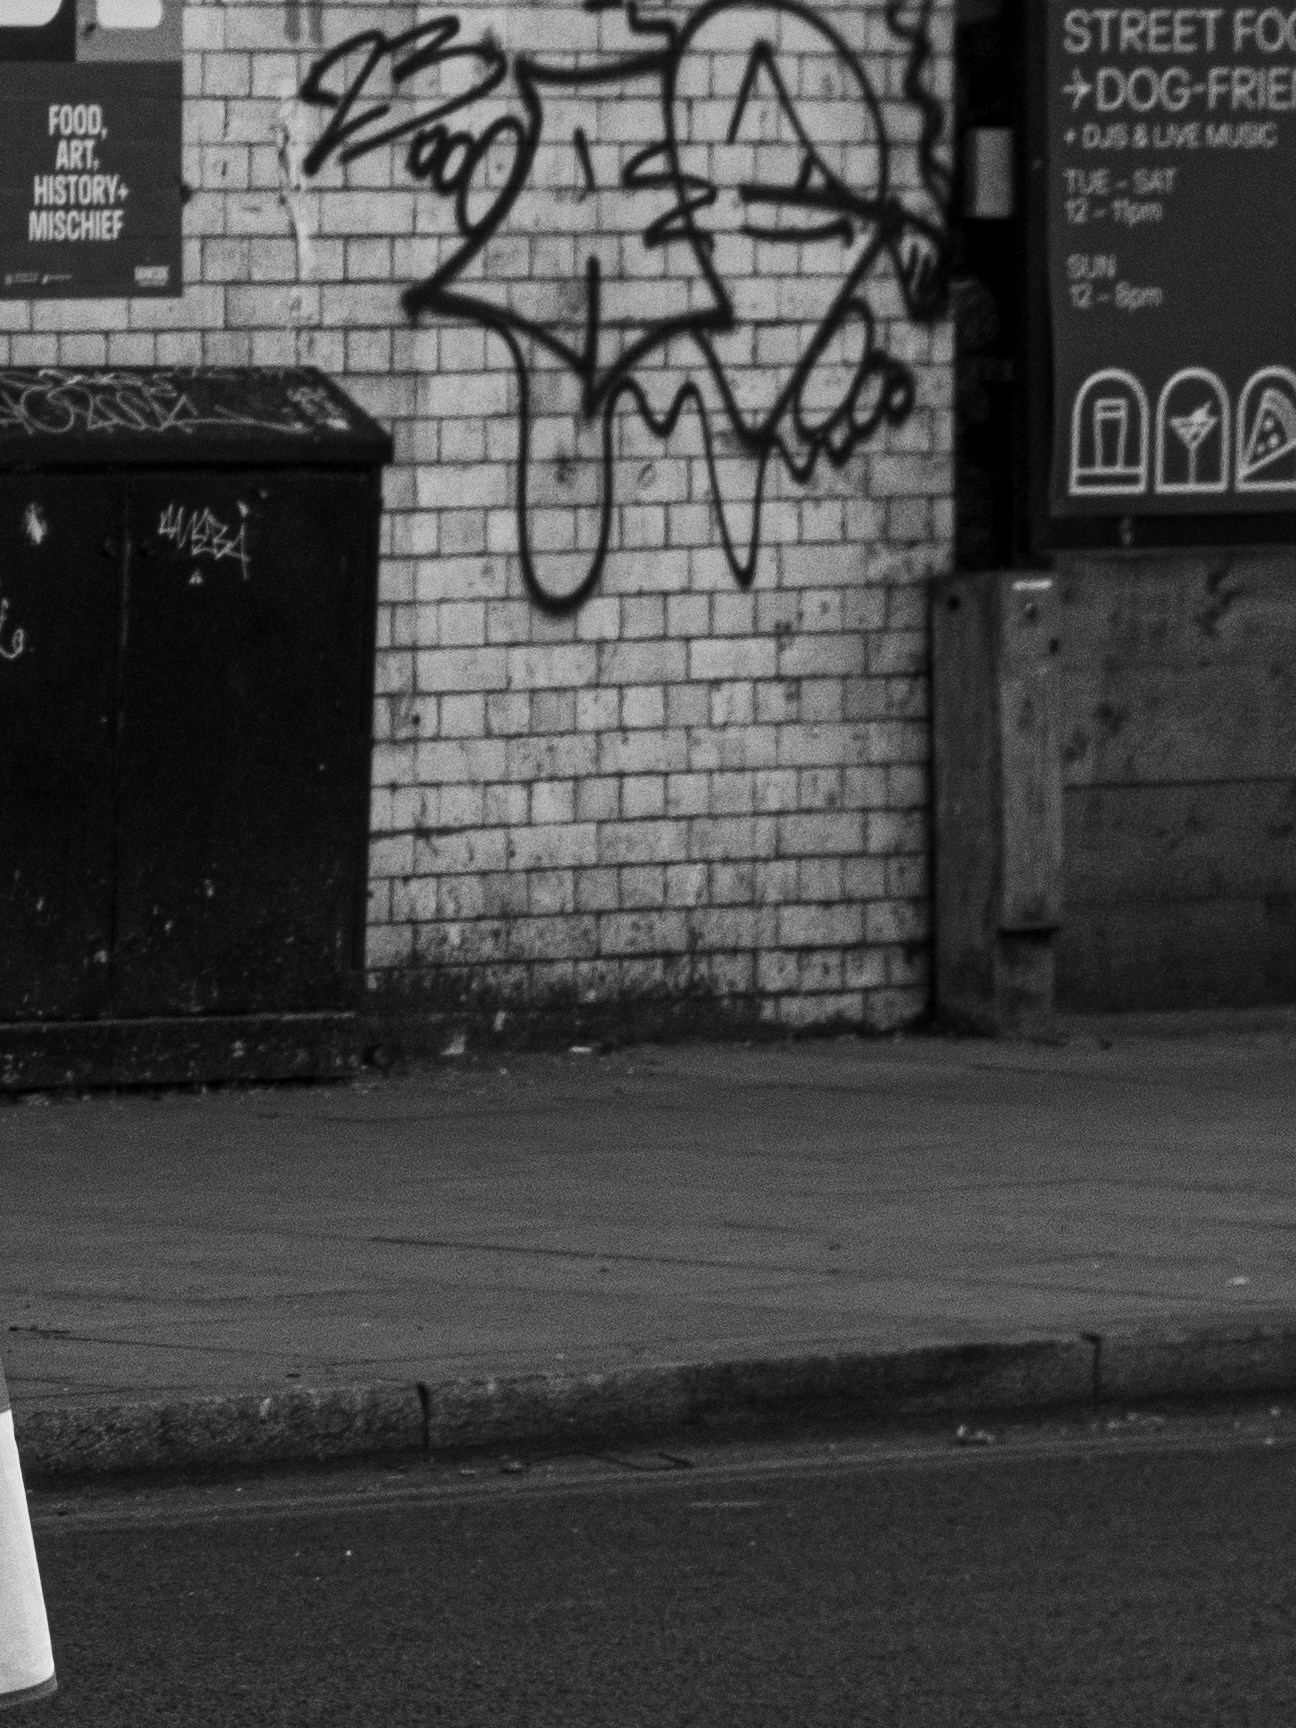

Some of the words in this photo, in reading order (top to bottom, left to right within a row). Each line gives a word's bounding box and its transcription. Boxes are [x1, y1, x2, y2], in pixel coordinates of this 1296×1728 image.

[1063, 7, 1225, 54] STREET
[1095, 66, 1296, 114] DOG-FRIE
[47, 103, 108, 140] FOOD,
[1152, 122, 1201, 149] LIVE
[1205, 121, 1278, 149] MUSIC
[54, 138, 100, 172] ART,
[32, 173, 130, 206] HISTORY+
[28, 209, 125, 242] MISCHIEF
